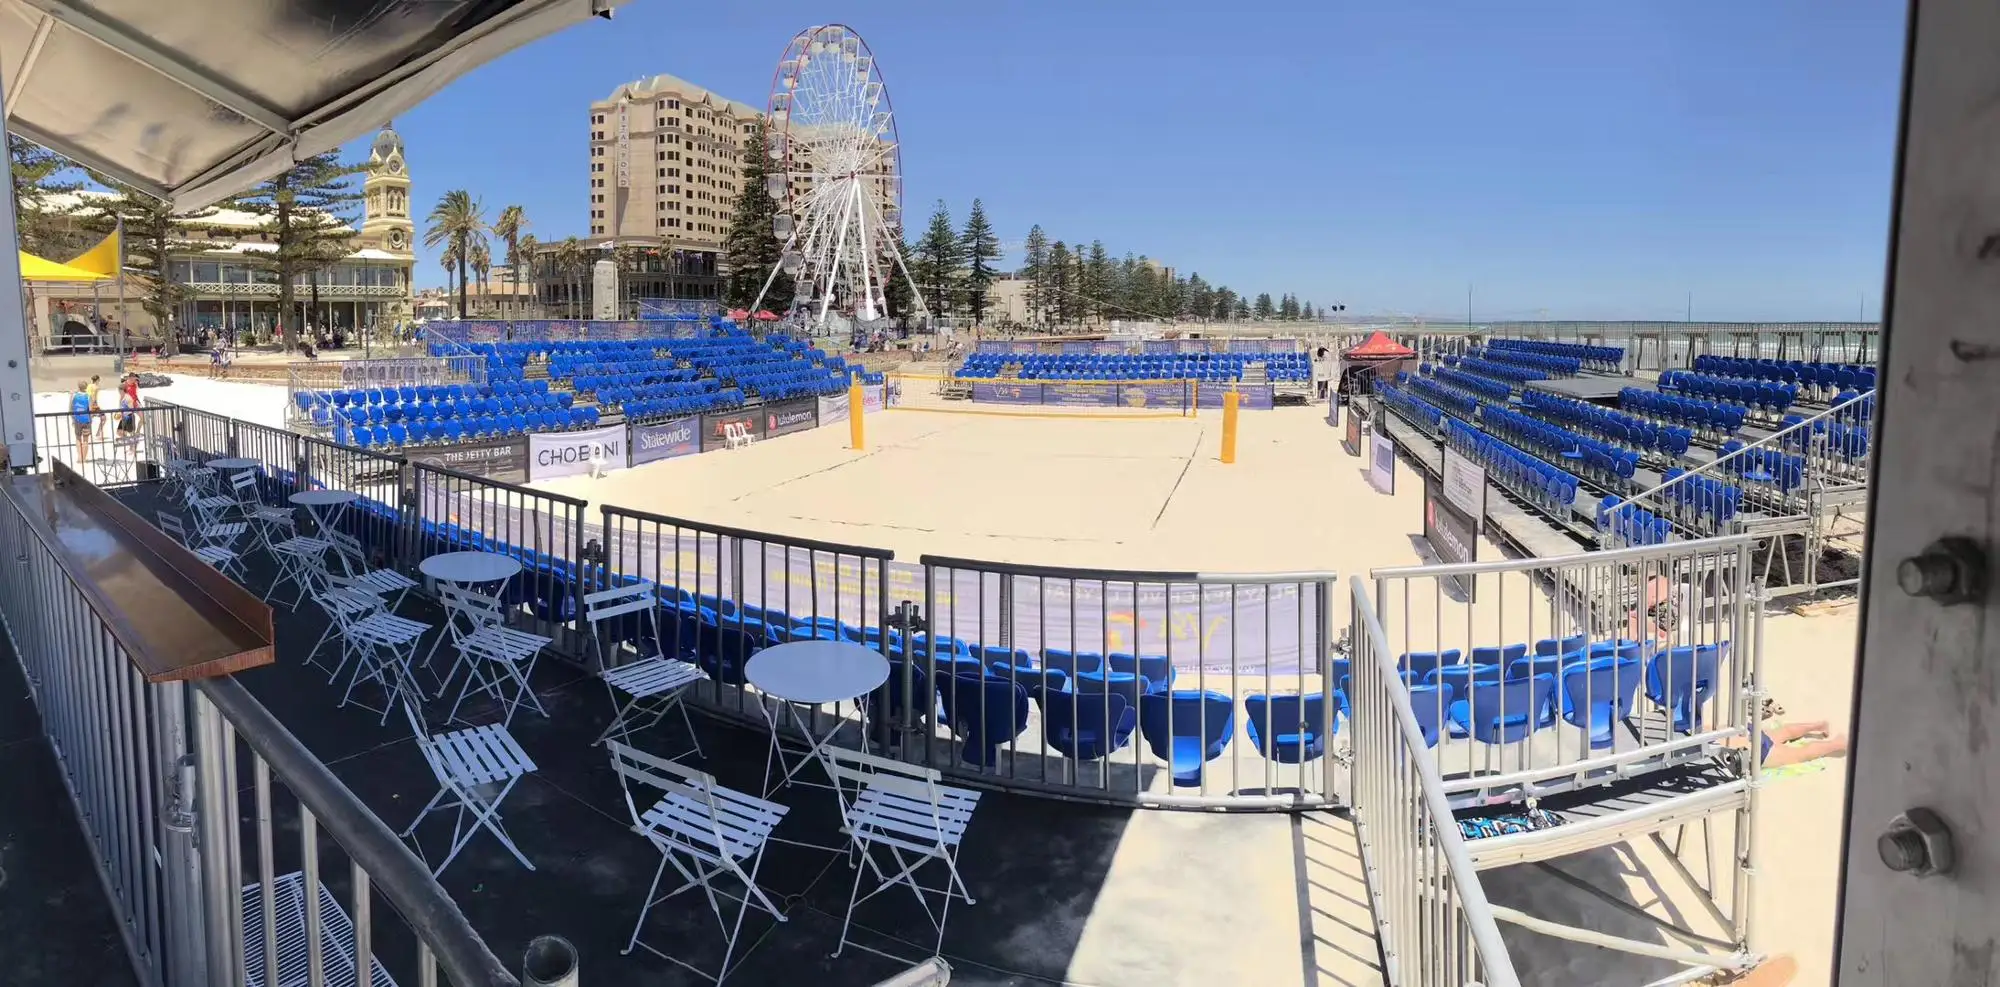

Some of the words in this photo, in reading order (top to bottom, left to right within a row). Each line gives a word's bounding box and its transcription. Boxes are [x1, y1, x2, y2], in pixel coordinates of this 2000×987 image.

[641, 425, 691, 450] Statewide
[444, 452, 464, 462] THE
[493, 446, 513, 457] BAR
